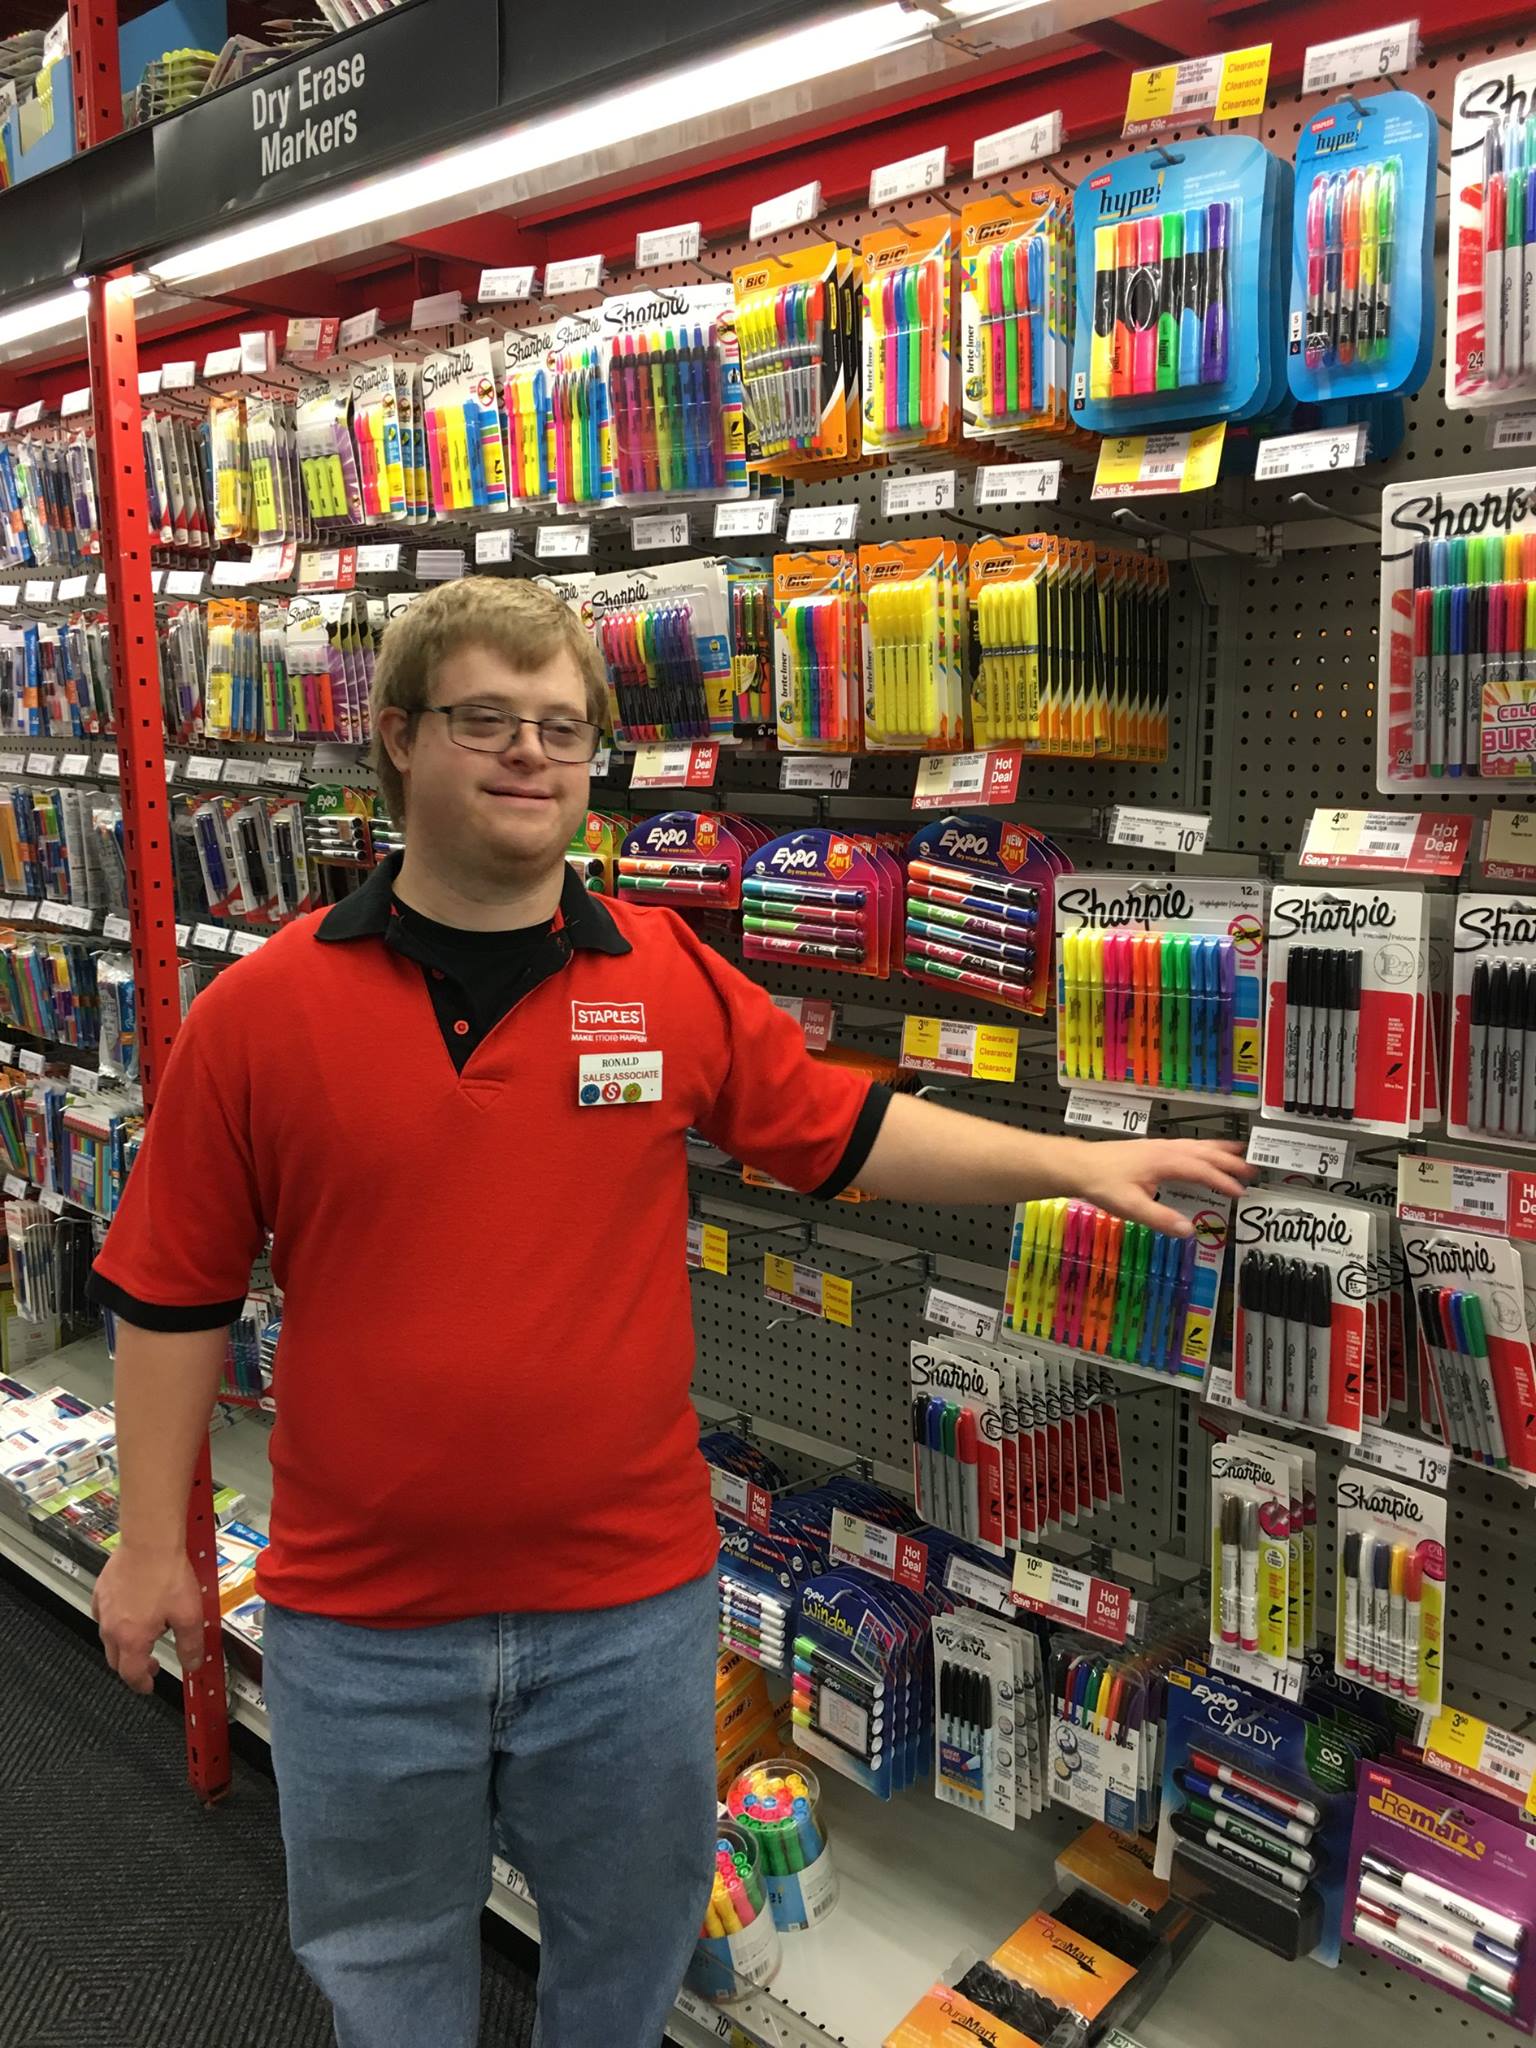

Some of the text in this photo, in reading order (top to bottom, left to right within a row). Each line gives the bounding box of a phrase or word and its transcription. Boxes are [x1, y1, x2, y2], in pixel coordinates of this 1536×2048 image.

[1228, 59, 1266, 73] Clearance
[252, 53, 366, 131] Dry Erase
[1225, 78, 1263, 91] Clearance
[1222, 98, 1260, 111] Clearance
[1451, 73, 1536, 156] Sh
[1127, 122, 1148, 135] Save
[1312, 118, 1334, 132] STAPLES
[261, 107, 358, 177] Markers
[1317, 125, 1363, 152] hype!
[1090, 175, 1111, 188] STAPLES
[1100, 176, 1163, 218] hype!
[745, 272, 767, 289] BIC
[604, 290, 690, 331] Sharpie
[506, 331, 554, 369] Sharpie
[1468, 352, 1484, 370] 24
[354, 366, 390, 400] Sharpie
[423, 350, 474, 400] Sharpie
[1329, 443, 1349, 468] 329
[1096, 486, 1116, 496] Save
[344, 553, 352, 563] Hot
[983, 557, 1014, 574] BIC
[341, 564, 352, 573] Deal
[873, 563, 901, 579] BIC
[591, 580, 648, 621] Sharpie
[285, 604, 321, 631] Sharpie
[1500, 705, 1536, 719] COLO
[1482, 728, 1536, 751] BUR
[698, 748, 712, 758] Hot
[1398, 750, 1412, 765] 24
[695, 758, 712, 769] Deal
[995, 758, 1012, 769] Hot
[992, 770, 1013, 783] Deal
[915, 798, 931, 807] Save
[1332, 812, 1348, 824] 400
[700, 823, 714, 833] NEW
[1431, 823, 1459, 838] Hot
[647, 828, 688, 851] EXPO
[939, 829, 989, 857] EXPO
[1006, 834, 1022, 846] NEW
[1177, 829, 1204, 852] 1079
[1424, 837, 1458, 852] Deal
[833, 843, 848, 854] NEW
[771, 847, 817, 872] EXPO
[1304, 854, 1329, 866] Save
[1487, 863, 1514, 877] Save
[1056, 882, 1194, 937] Sharpie
[1268, 896, 1396, 940] Sharpie
[1454, 907, 1536, 953] Sha
[578, 1010, 640, 1024] STAPLES
[808, 1010, 825, 1022] New
[804, 1022, 825, 1035] Price
[571, 1033, 593, 1041] MAKE
[595, 1034, 618, 1042] more
[981, 1033, 1014, 1044] Clearance
[904, 1056, 921, 1064] Save
[980, 1048, 1013, 1058] Clearance
[602, 1057, 639, 1067] RONALD
[978, 1062, 1012, 1073] Clearance
[583, 1070, 659, 1082] SALES ASSOCIATE
[1318, 1152, 1339, 1174] 599
[1418, 1162, 1434, 1175] 400
[1401, 1206, 1426, 1219] Save
[1520, 1200, 1536, 1215] De
[1235, 1206, 1352, 1250] Sharpie
[1407, 1239, 1495, 1280] Sharpie
[911, 1355, 989, 1397] Sharpie
[1211, 1458, 1275, 1485] Sharpie
[1418, 1457, 1447, 1483] 1399
[753, 1491, 766, 1504] Hot
[1337, 1483, 1423, 1522] Sharpie
[752, 1502, 767, 1518] Deal
[905, 1545, 921, 1560] Hot
[902, 1556, 922, 1572] Deal
[1012, 1593, 1031, 1609] Save
[1099, 1588, 1119, 1606] Hot
[803, 1598, 854, 1637] Window
[1096, 1601, 1120, 1621] Deal
[1192, 1684, 1239, 1712] EXPO
[1208, 1706, 1282, 1751] CADDY
[1427, 1752, 1451, 1771] Save
[1041, 1926, 1096, 1967] DuraMark
[939, 1999, 1000, 2045] DuraMark
